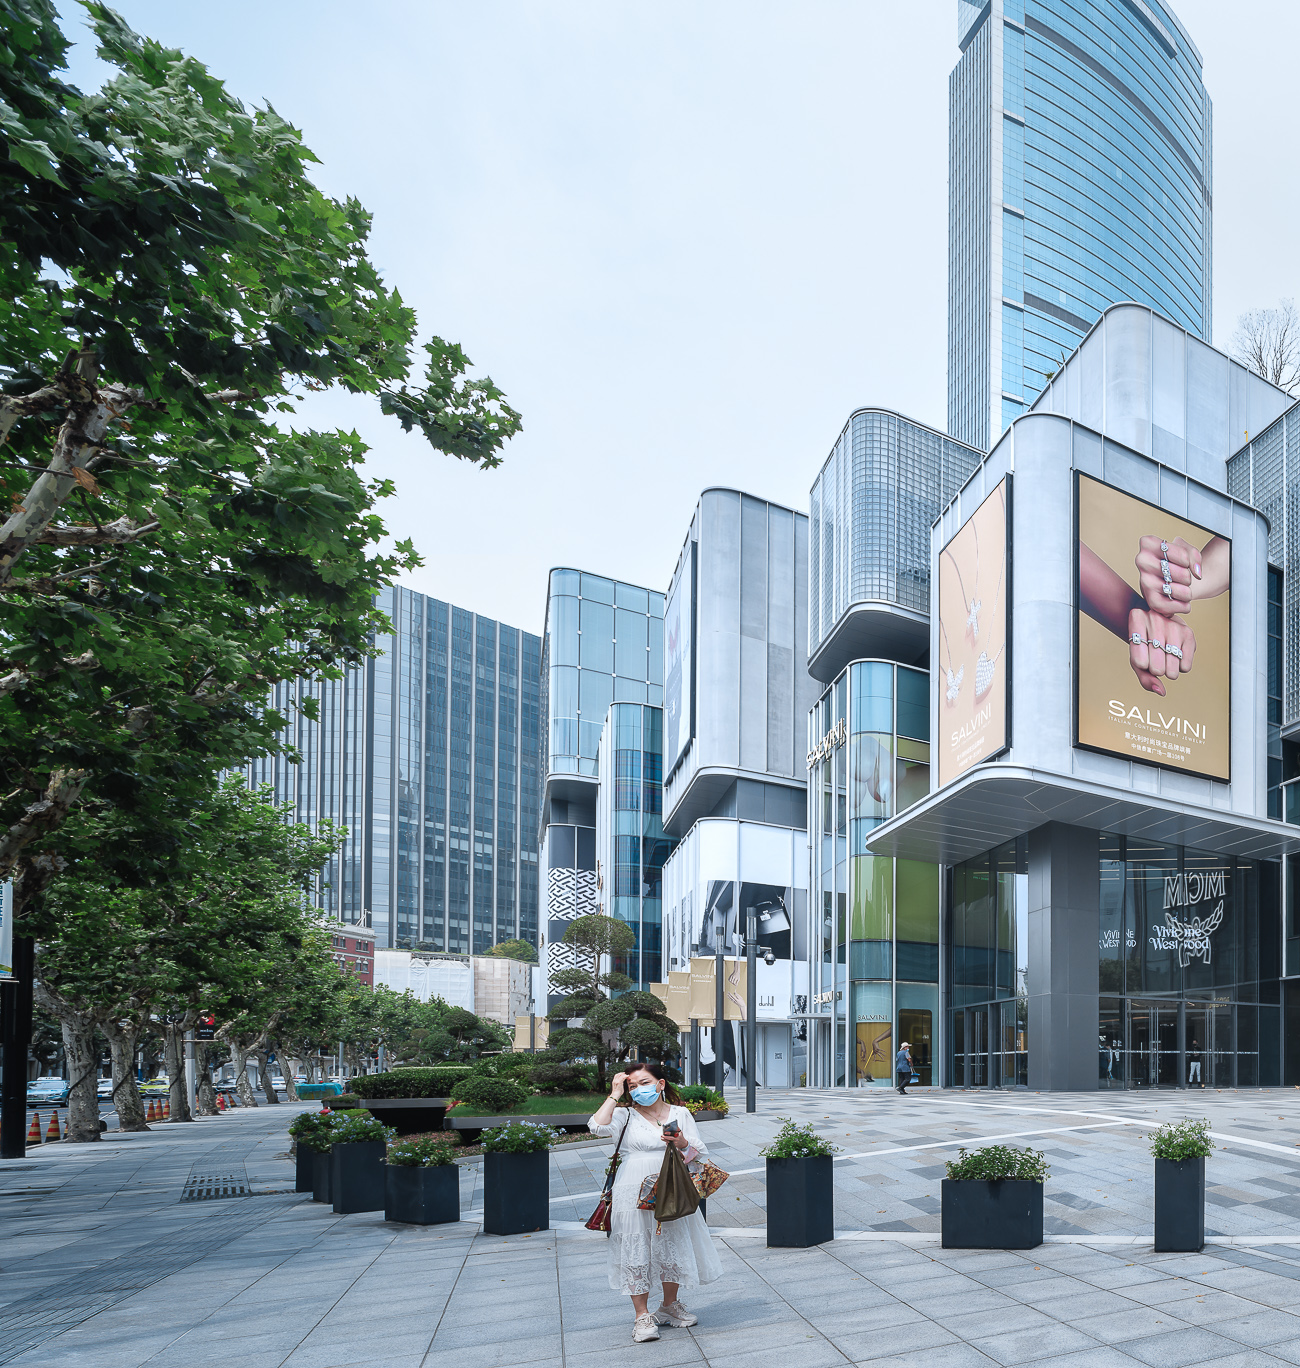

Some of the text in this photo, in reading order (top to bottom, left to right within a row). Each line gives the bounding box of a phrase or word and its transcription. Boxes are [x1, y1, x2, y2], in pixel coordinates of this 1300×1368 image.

[951, 703, 991, 747] SALVINI
[1108, 700, 1206, 739] SALVINI
[1108, 716, 1206, 745] ITALIAN CONTEMPORARY JEWELRY
[758, 995, 774, 1006] dunhill
